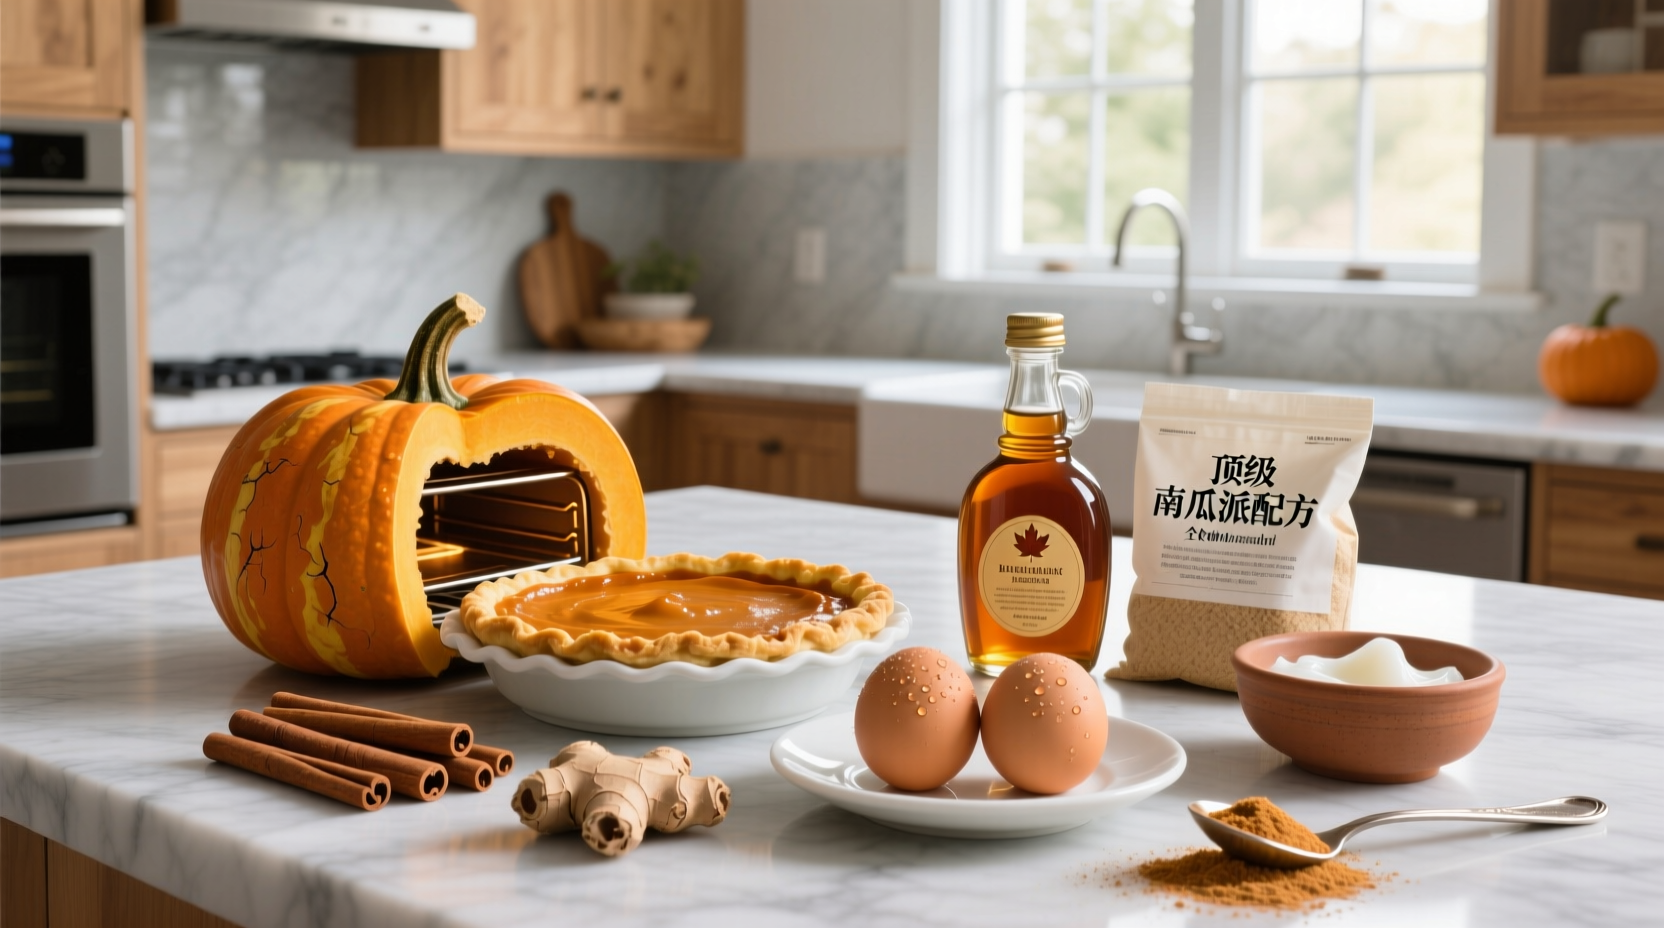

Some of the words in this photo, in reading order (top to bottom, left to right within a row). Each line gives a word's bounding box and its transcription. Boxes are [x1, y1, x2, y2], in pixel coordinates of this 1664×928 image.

[1209, 454, 1277, 488] 顶级
[1153, 485, 1319, 529] 南瓜派配方
